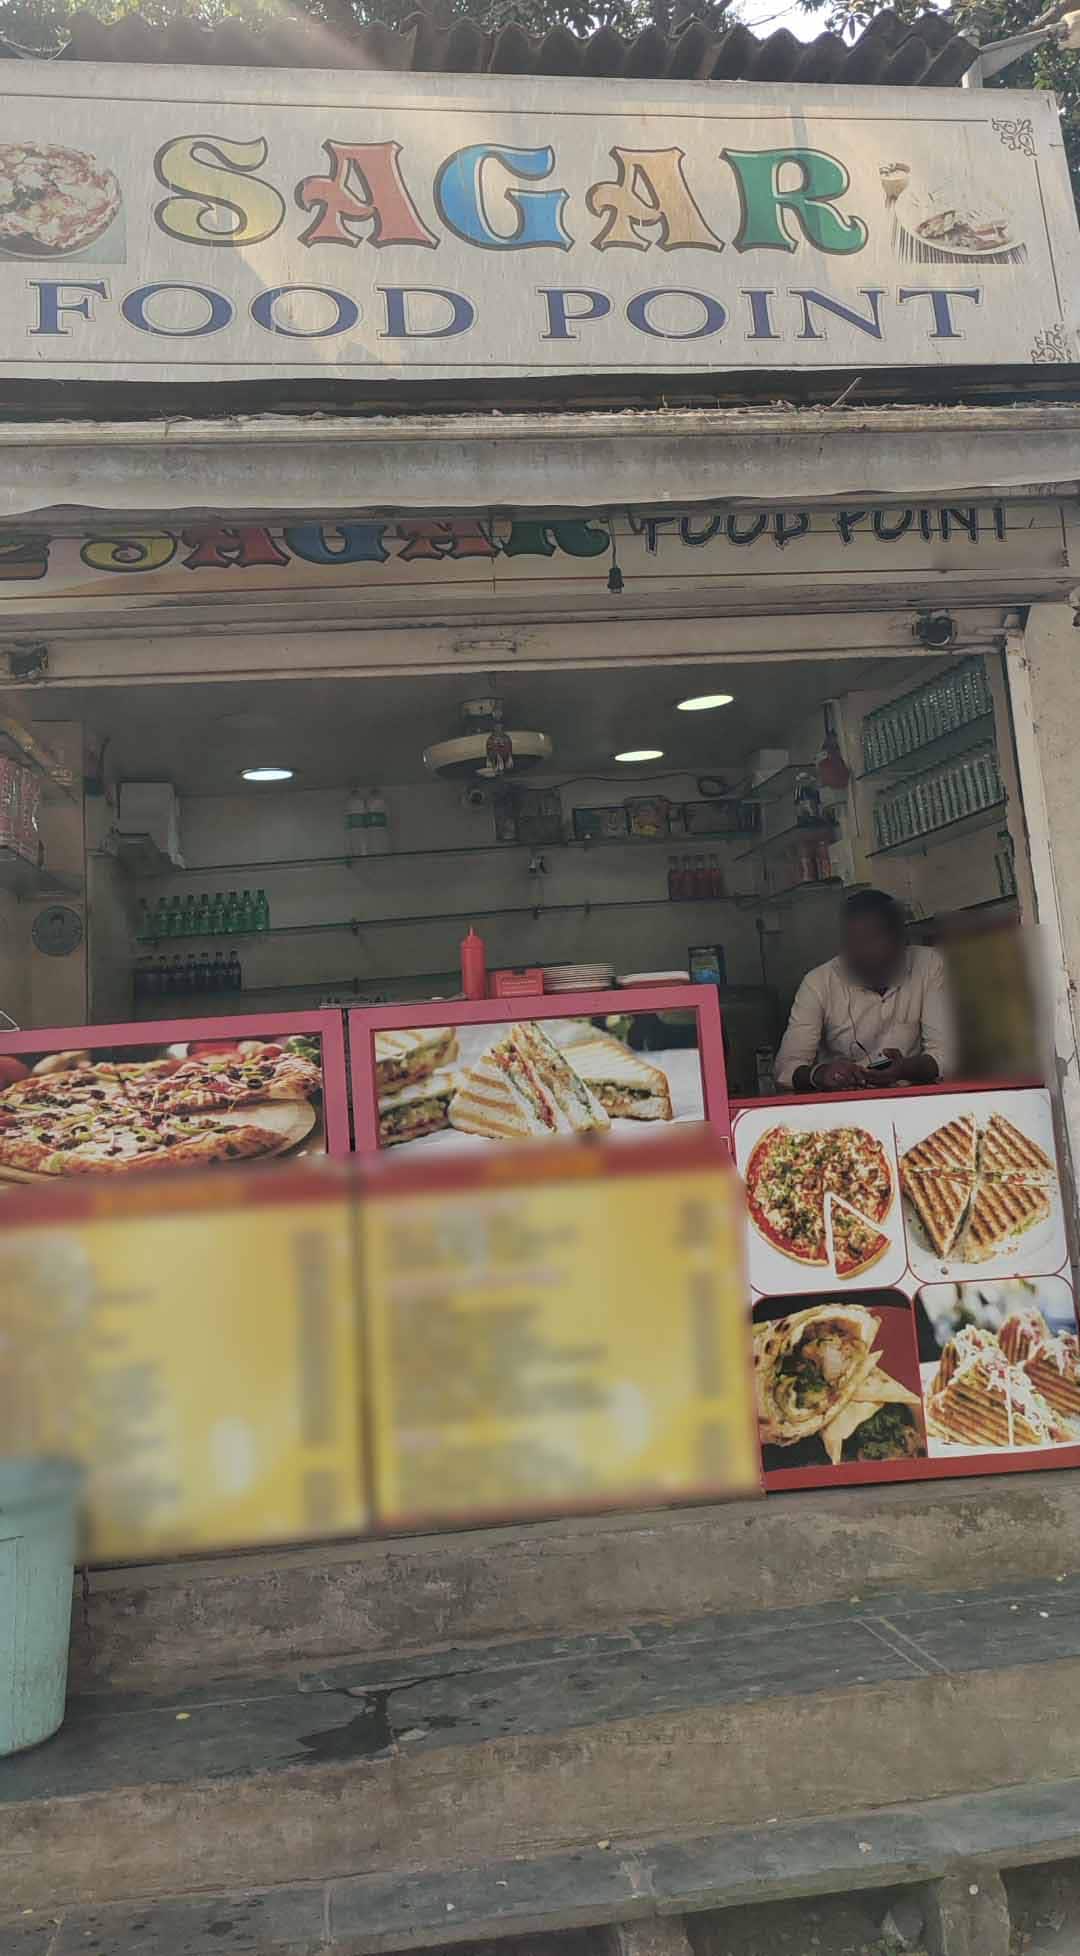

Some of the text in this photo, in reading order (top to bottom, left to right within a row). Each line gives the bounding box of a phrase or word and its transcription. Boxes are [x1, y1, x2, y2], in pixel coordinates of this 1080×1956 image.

[153, 133, 868, 254] SAGAR
[28, 279, 983, 342] FOOD POINT
